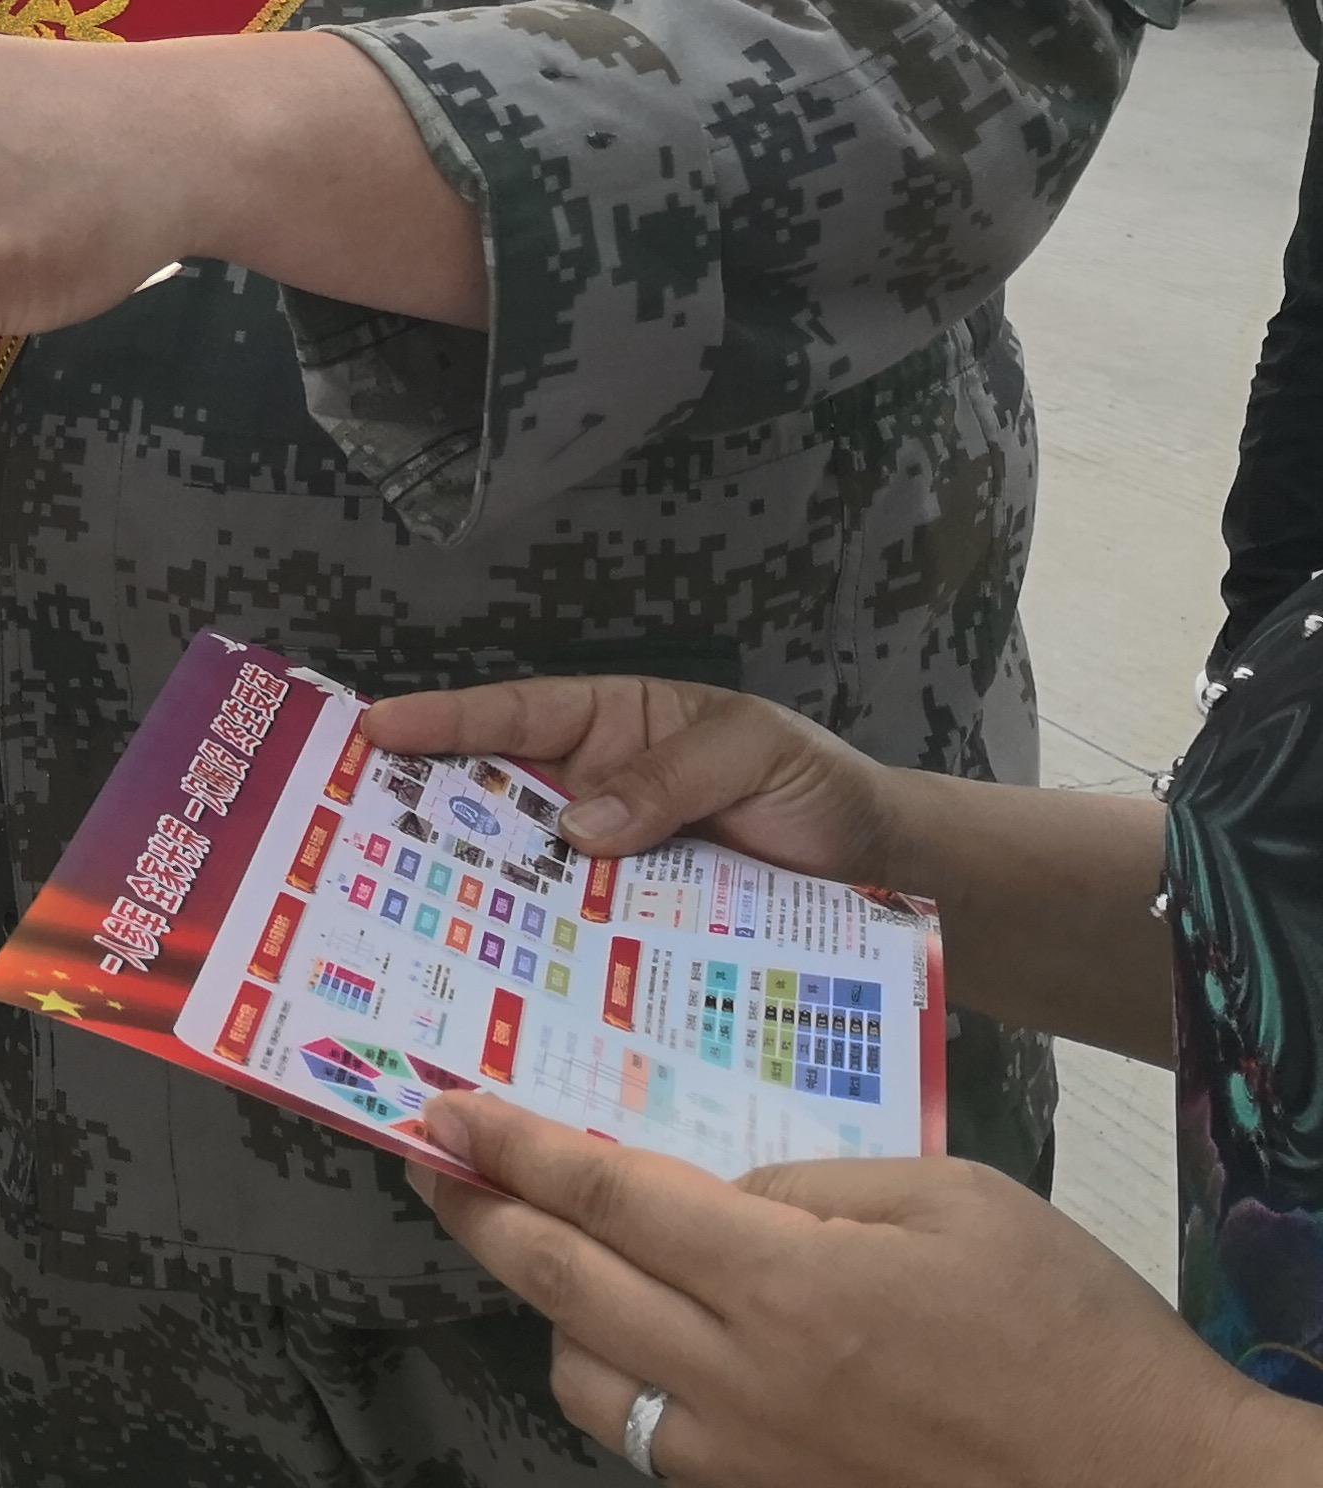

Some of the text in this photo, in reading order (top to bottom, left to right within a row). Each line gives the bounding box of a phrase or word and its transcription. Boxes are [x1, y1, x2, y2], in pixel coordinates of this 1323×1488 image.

[93, 662, 290, 975] 一人参军 全家光荣 一次服役 终生受益
